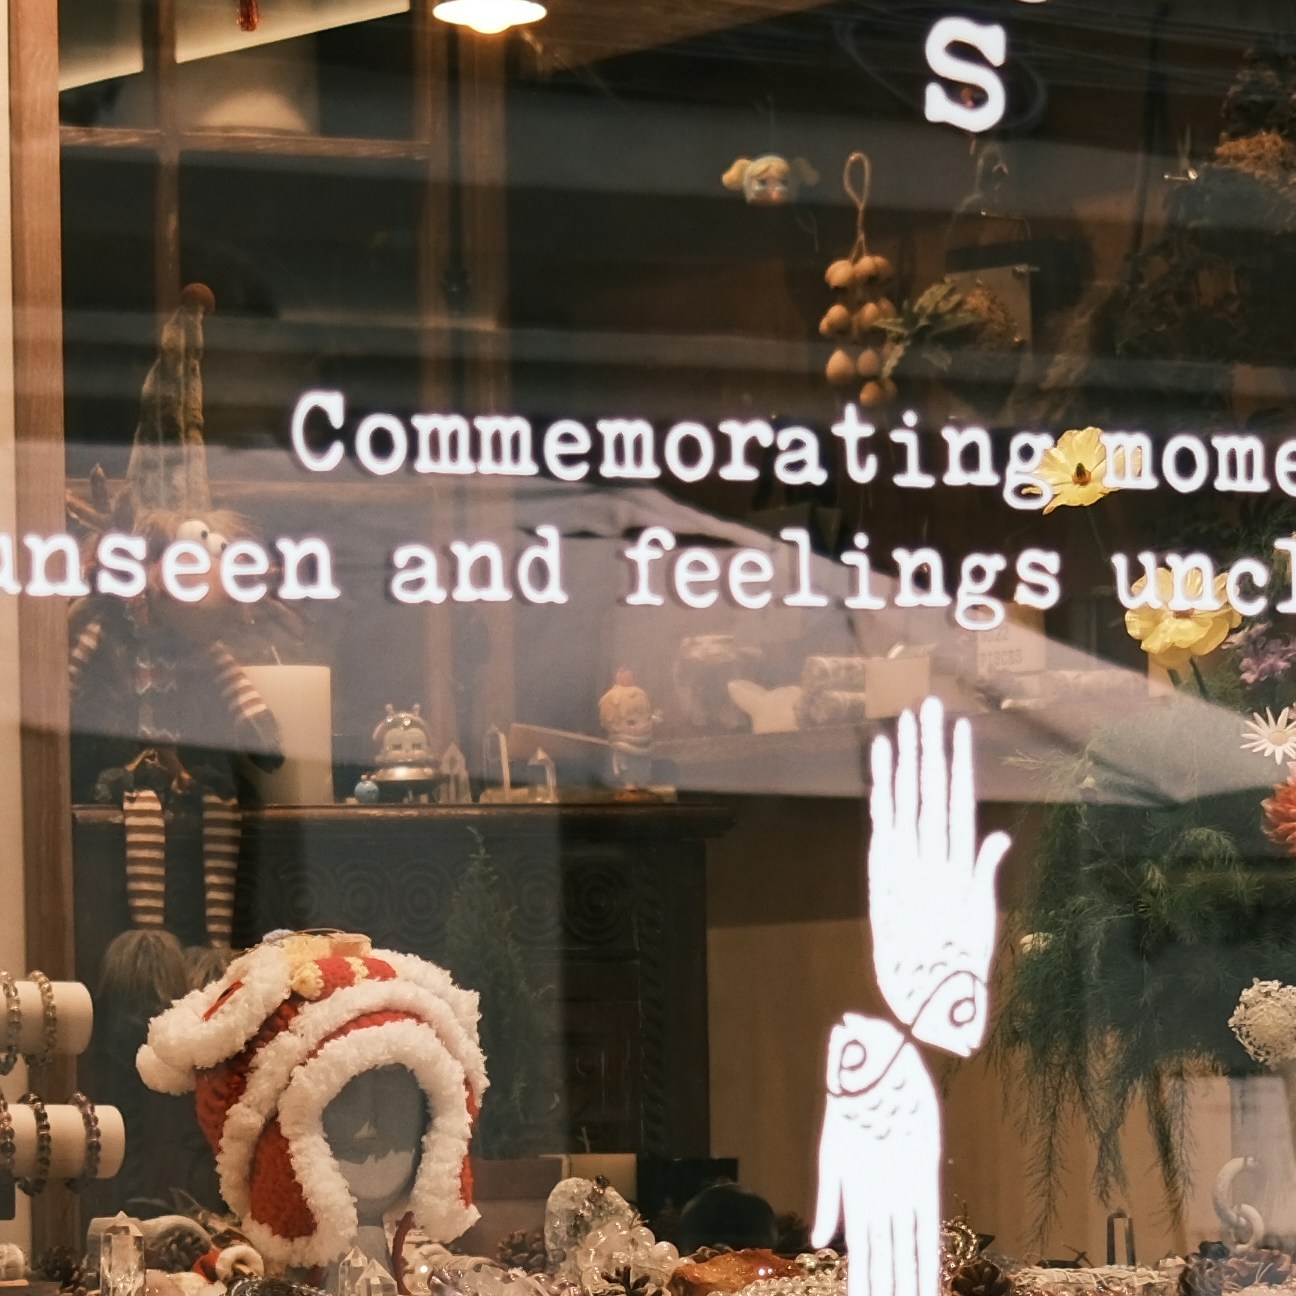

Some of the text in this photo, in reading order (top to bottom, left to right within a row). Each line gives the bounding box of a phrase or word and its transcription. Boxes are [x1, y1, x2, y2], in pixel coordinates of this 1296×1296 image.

[924, 16, 1006, 133] S
[290, 390, 1056, 512] Commemorating
[390, 523, 570, 608] and
[623, 524, 1061, 633] feelings
